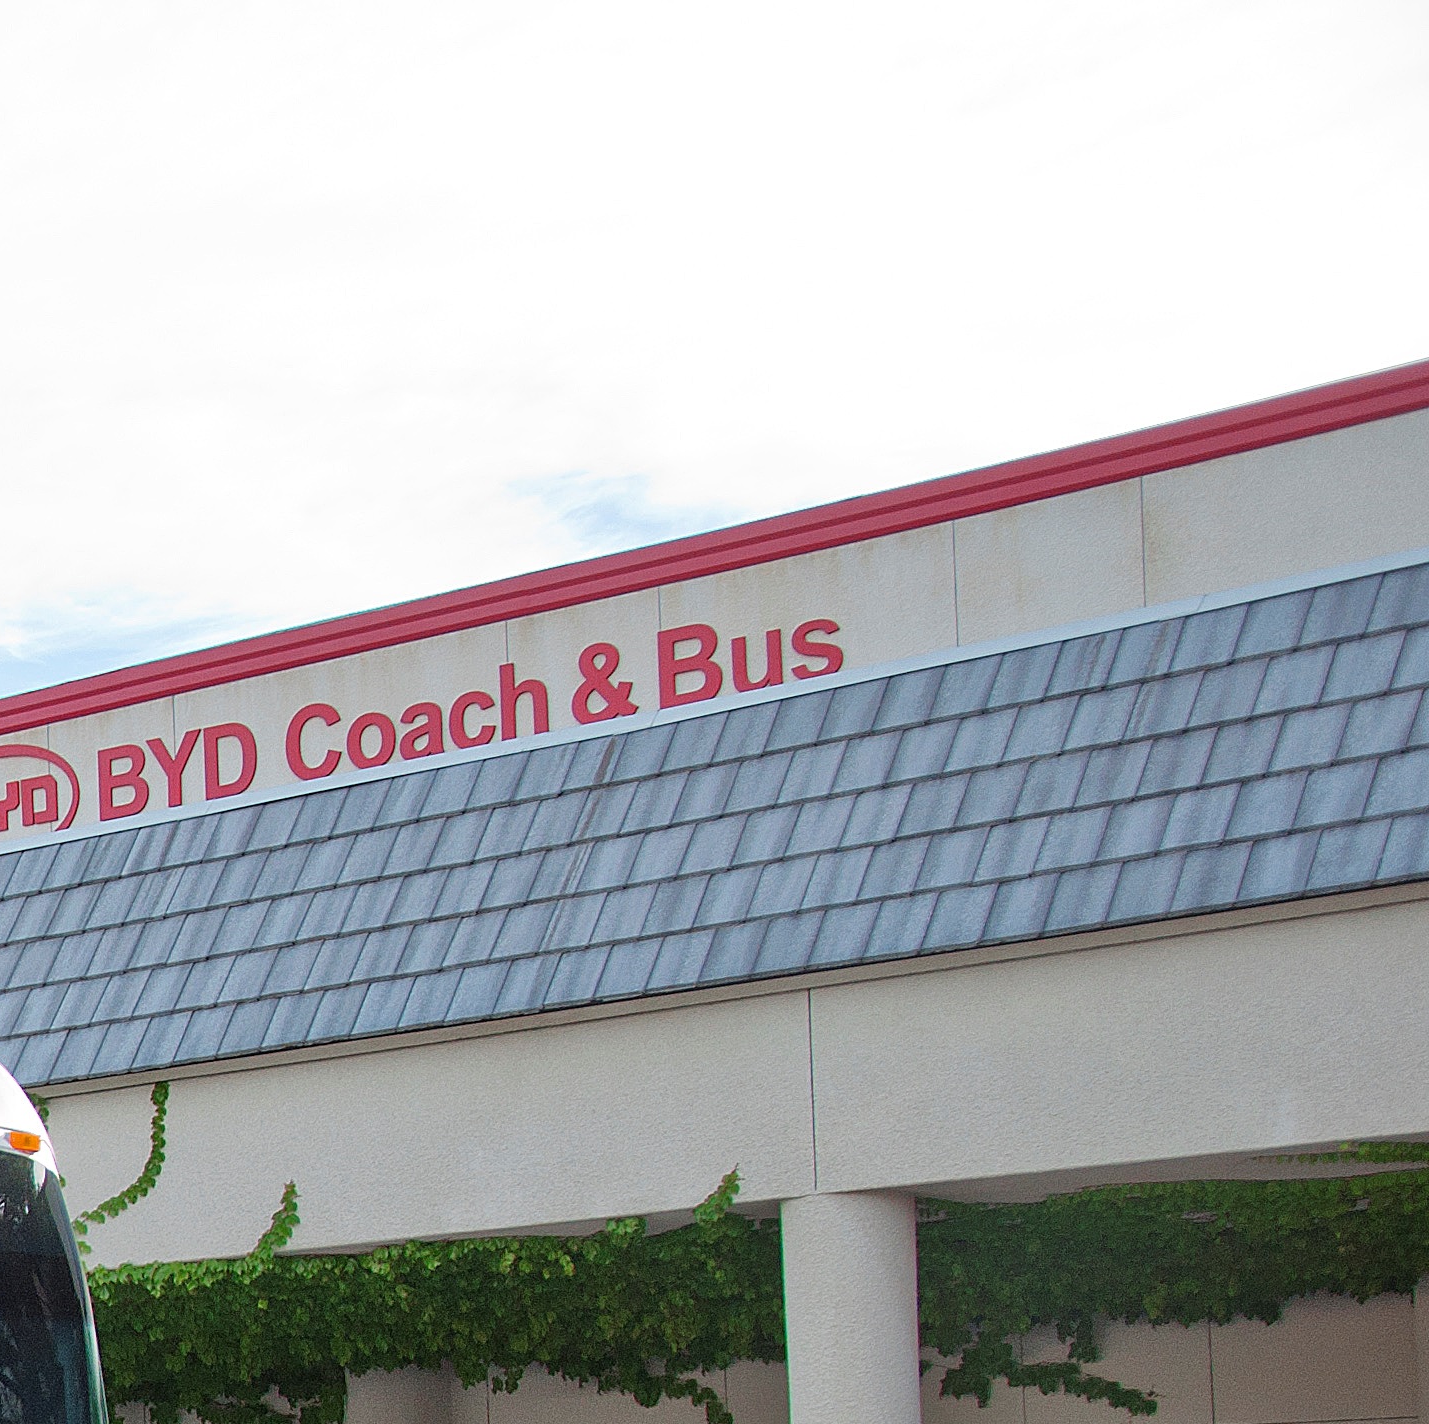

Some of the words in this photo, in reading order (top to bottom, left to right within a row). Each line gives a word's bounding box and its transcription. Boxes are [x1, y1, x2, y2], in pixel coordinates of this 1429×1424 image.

[97, 722, 257, 822] BYD
[284, 663, 550, 782] Coach
[571, 642, 638, 725] &
[656, 618, 844, 709] Bus
